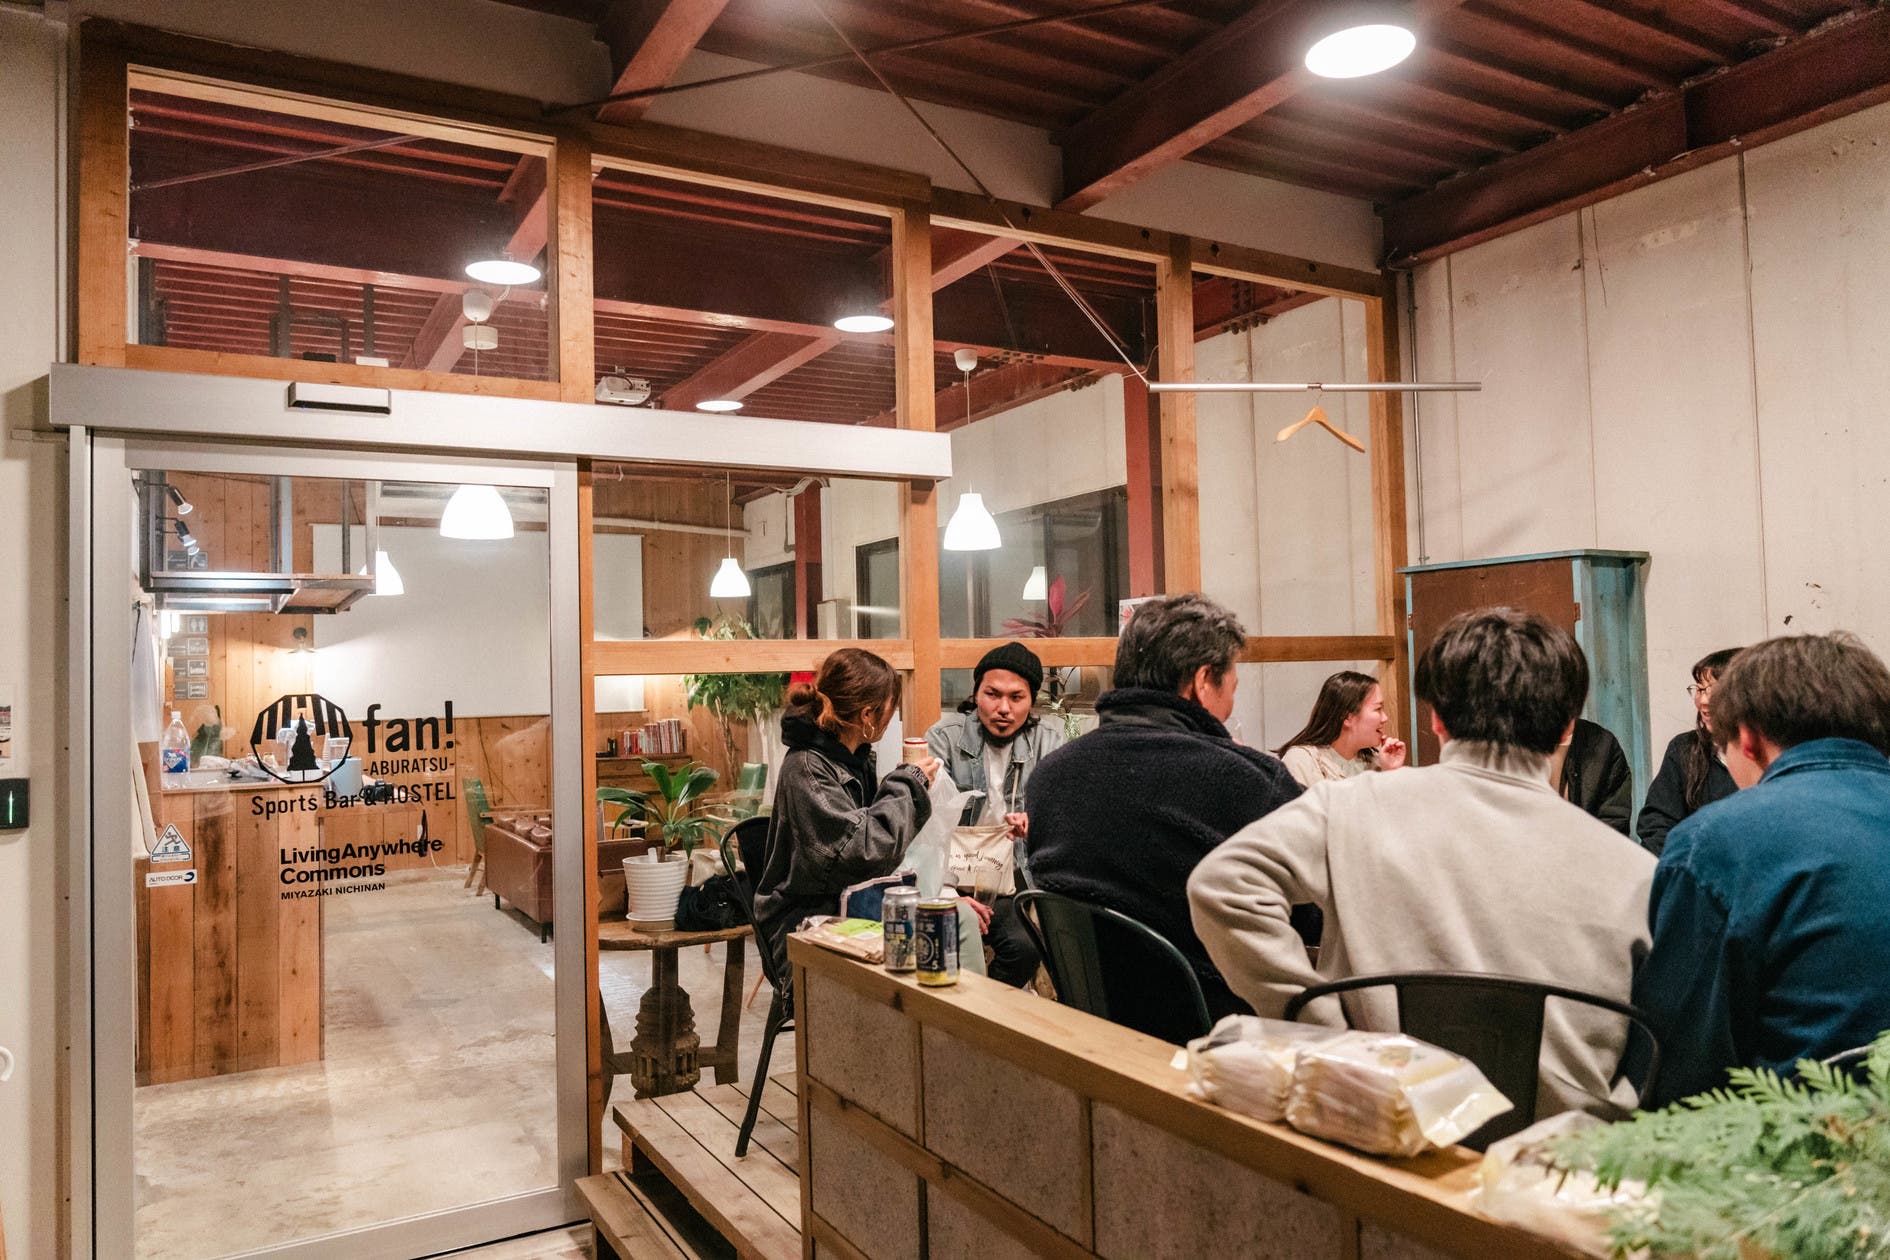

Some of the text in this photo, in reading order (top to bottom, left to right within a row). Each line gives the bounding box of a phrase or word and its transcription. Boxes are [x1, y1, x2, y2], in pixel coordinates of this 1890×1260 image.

[362, 700, 455, 754] fan!
[251, 795, 317, 820] Sports
[325, 790, 358, 810] Bar
[384, 781, 456, 805] HOSTEL
[280, 838, 443, 865] LivingAnywhere
[280, 861, 385, 885] Commons
[280, 882, 386, 900] MIYAZAKI NICHINAN
